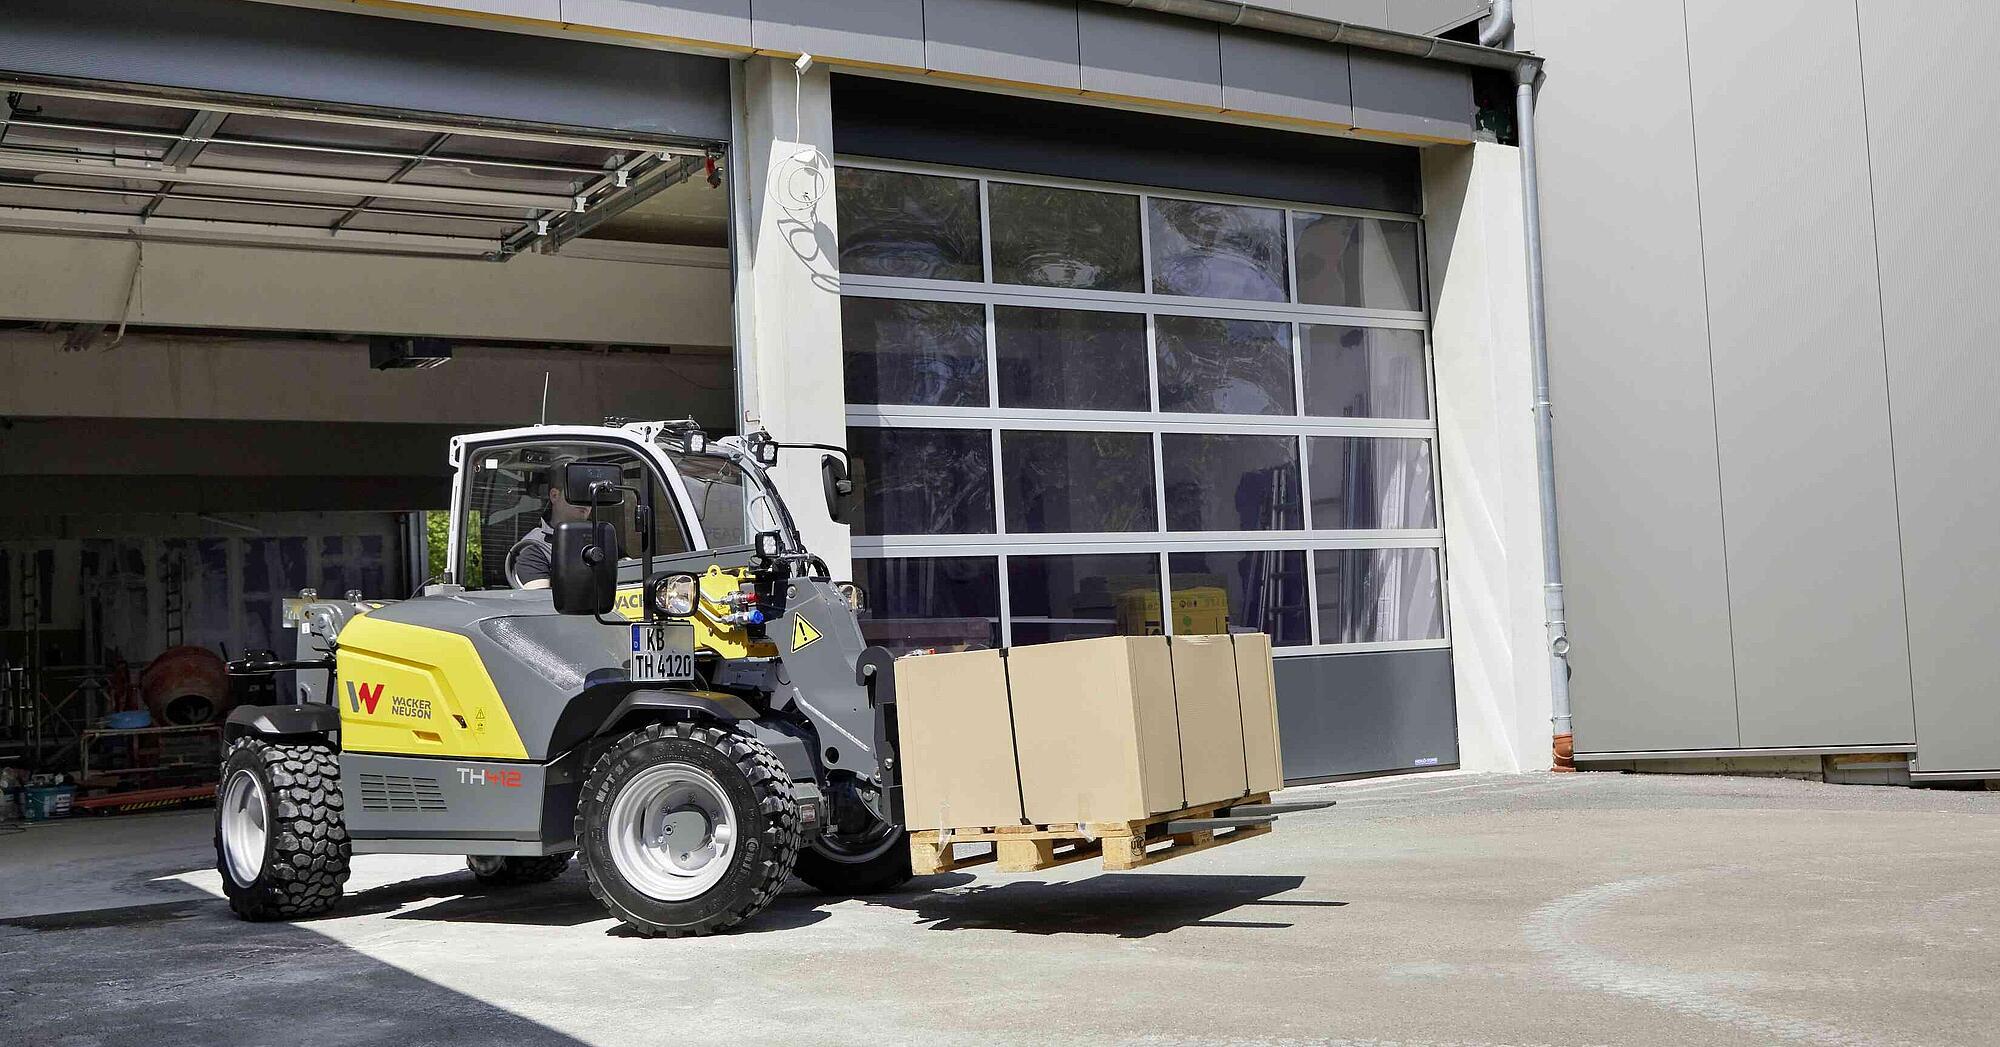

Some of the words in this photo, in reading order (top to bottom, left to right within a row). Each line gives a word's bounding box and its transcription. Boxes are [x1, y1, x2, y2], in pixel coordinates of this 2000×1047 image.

[647, 628, 665, 651] KB
[636, 654, 654, 678] TH
[657, 654, 692, 678] 4120
[391, 696, 432, 710] WACKER
[391, 705, 432, 720] NEUSON
[456, 767, 523, 788] TH412
